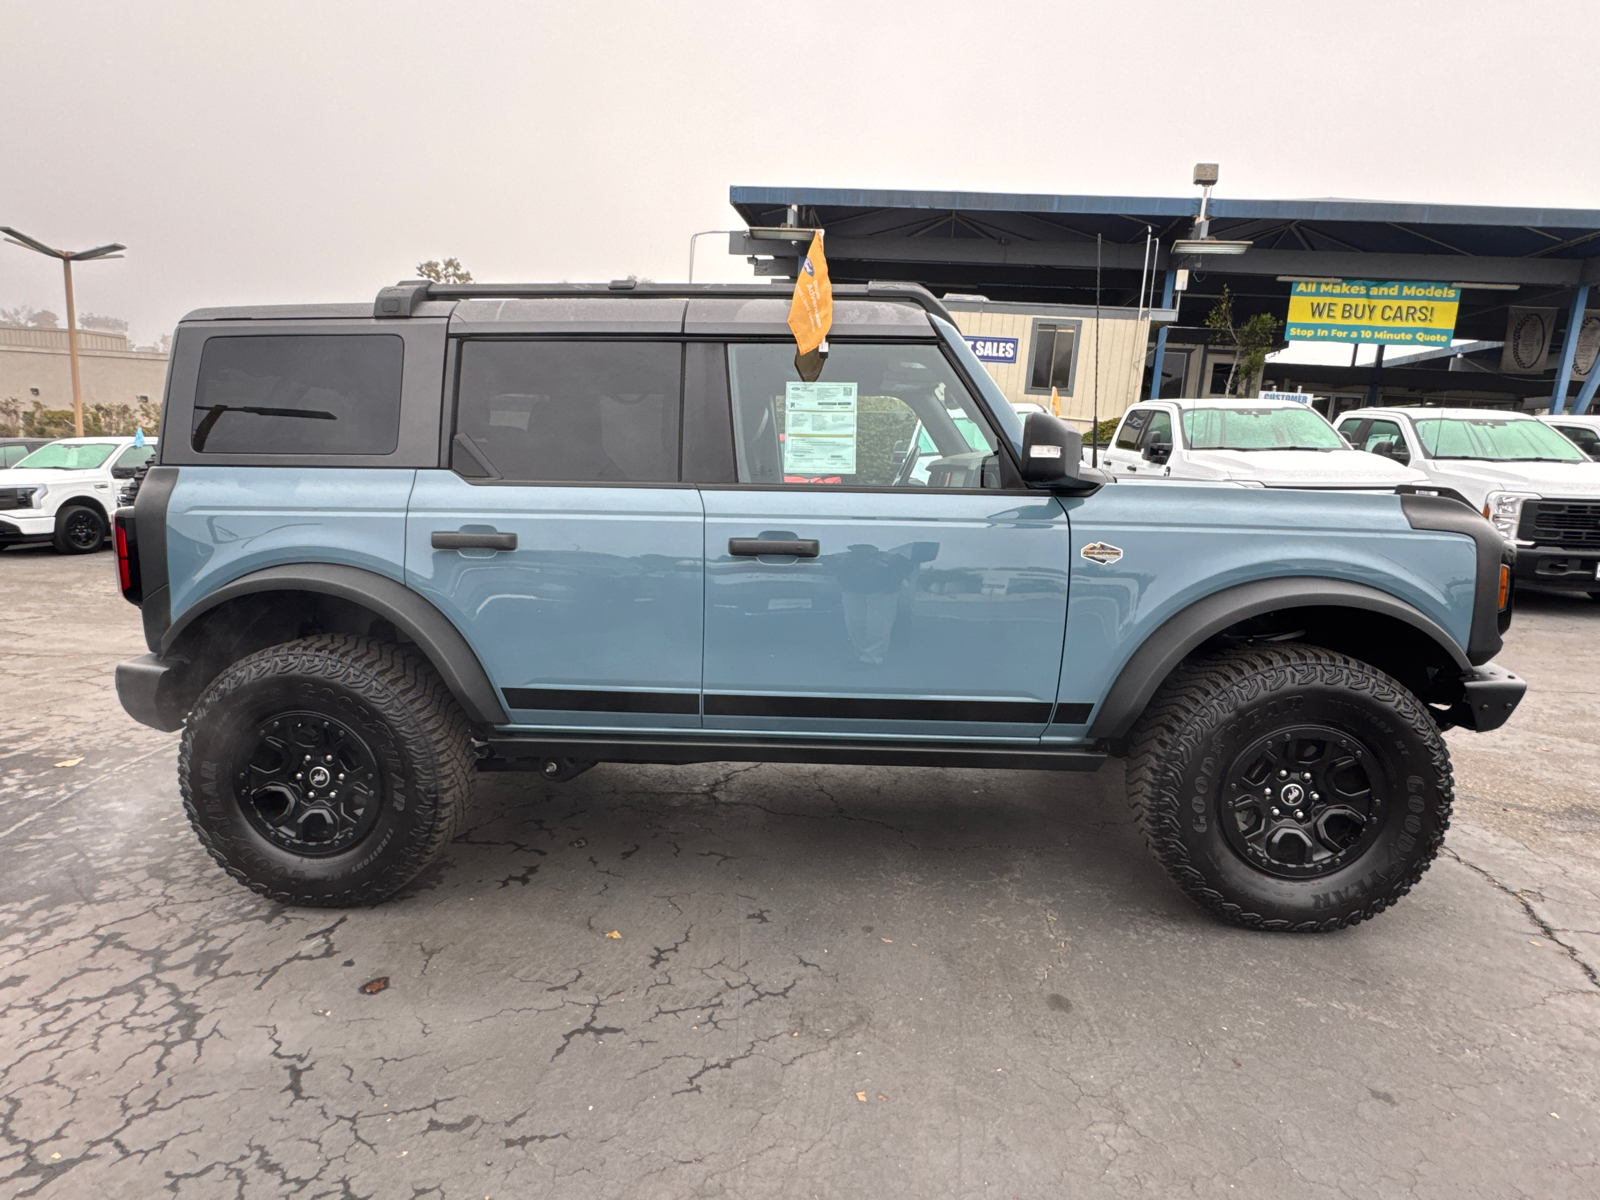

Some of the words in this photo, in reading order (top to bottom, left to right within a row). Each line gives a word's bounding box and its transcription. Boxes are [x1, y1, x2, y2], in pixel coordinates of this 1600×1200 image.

[1296, 282, 1317, 293] All
[1320, 282, 1367, 295] Makes
[1369, 285, 1399, 296] and
[1402, 286, 1456, 298] Models
[1310, 302, 1338, 319] WE
[1341, 303, 1377, 321] BUY
[1381, 305, 1435, 323] CARS!
[1289, 327, 1315, 338] Stop
[1317, 328, 1328, 337] In
[1331, 329, 1348, 338] For
[1361, 330, 1372, 338] 10
[1374, 330, 1413, 340] Minute
[1416, 332, 1448, 342] Quote
[975, 341, 1014, 358] SALES
[1264, 393, 1308, 404] CUSTOMER
